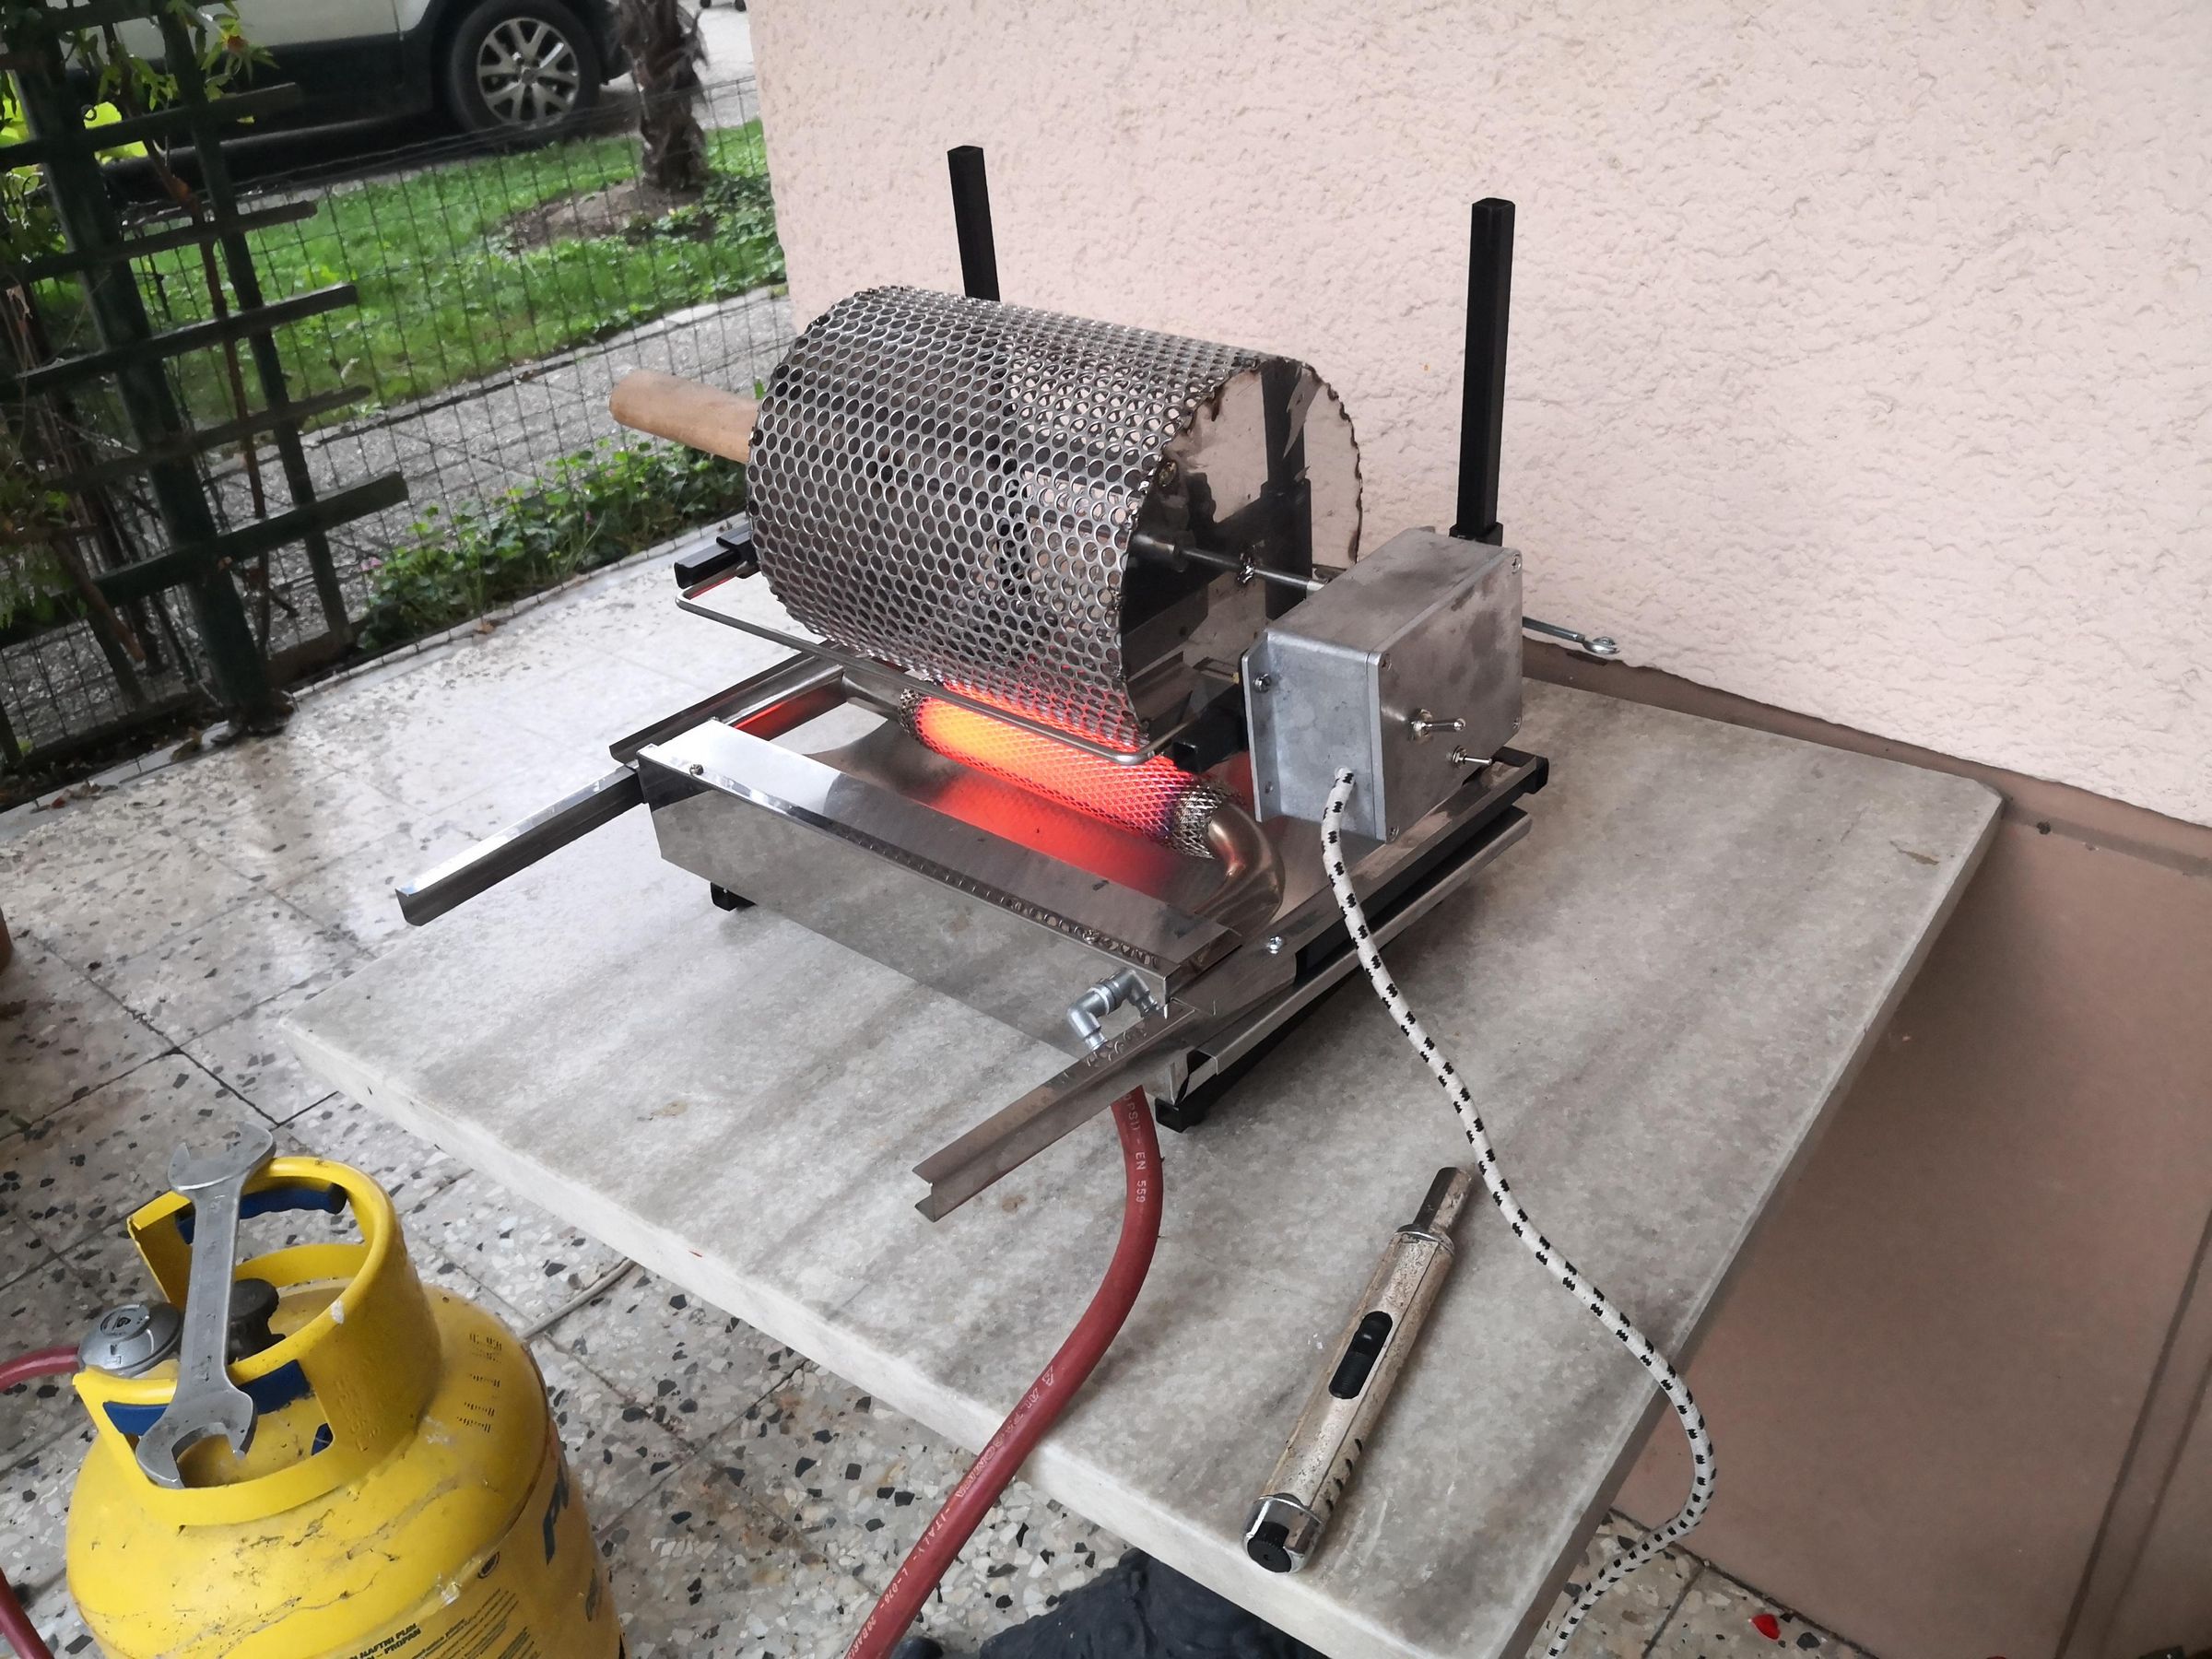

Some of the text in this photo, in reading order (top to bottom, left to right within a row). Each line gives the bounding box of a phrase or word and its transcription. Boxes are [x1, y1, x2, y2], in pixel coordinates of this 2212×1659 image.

[1135, 1151, 1147, 1171] EN
[1135, 1180, 1147, 1203] 559
[383, 1628, 421, 1654] PROPAN
